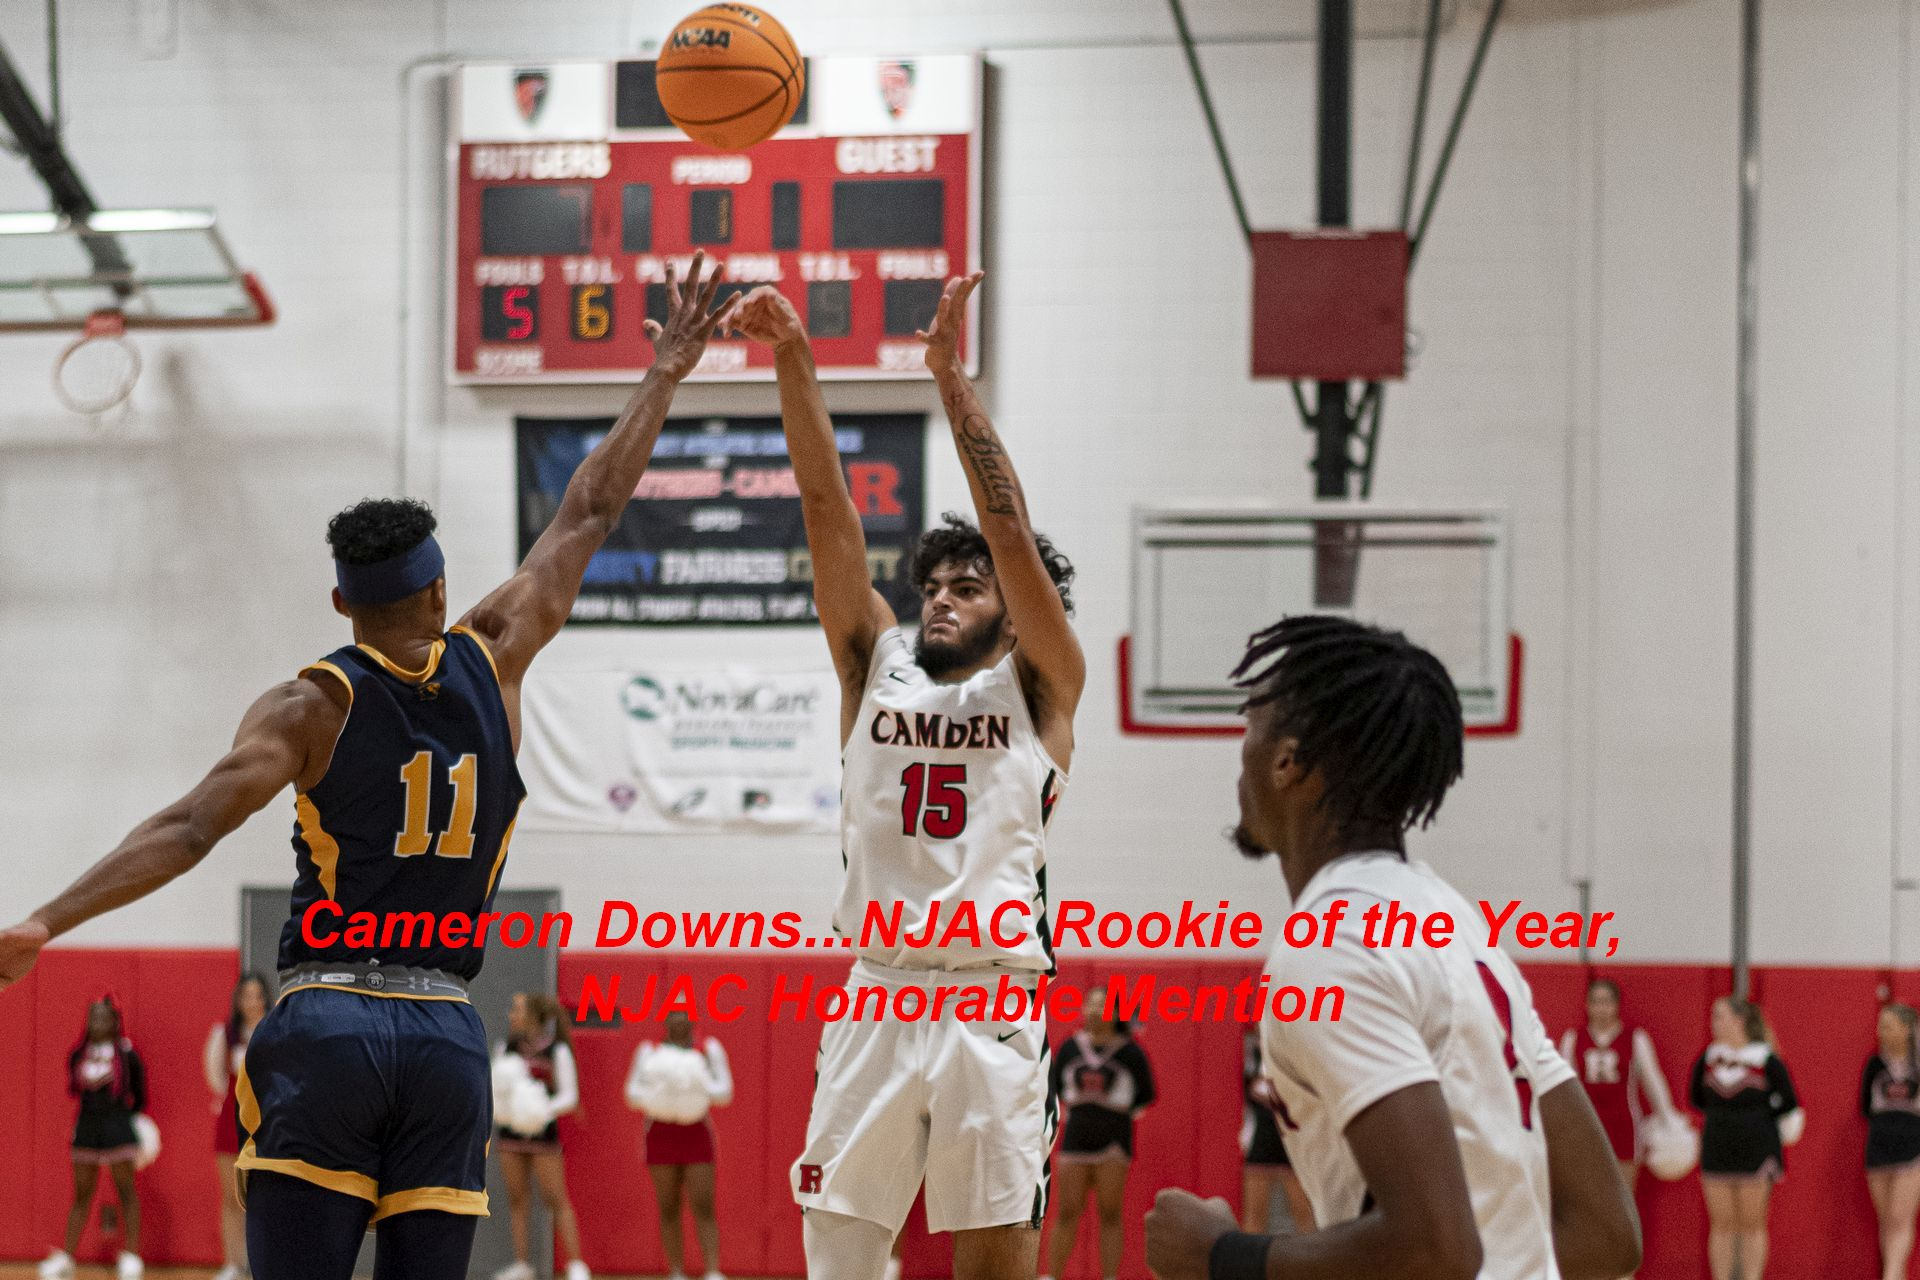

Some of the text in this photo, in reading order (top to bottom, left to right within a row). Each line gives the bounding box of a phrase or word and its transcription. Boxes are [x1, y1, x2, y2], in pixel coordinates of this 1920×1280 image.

[471, 143, 611, 180] RUTGERS
[671, 156, 751, 184] PERIOD
[836, 137, 939, 173] GUEST
[475, 258, 544, 285] FOULS
[877, 252, 949, 280] FOULS
[503, 287, 533, 339] 5
[578, 285, 609, 338] 6
[476, 347, 543, 375] SCORE
[848, 462, 903, 515] R
[675, 684, 816, 714] NovaCare
[871, 710, 1010, 750] CAMDEN
[394, 751, 477, 859] 11
[900, 762, 967, 839] 15
[799, 1164, 823, 1194] R
